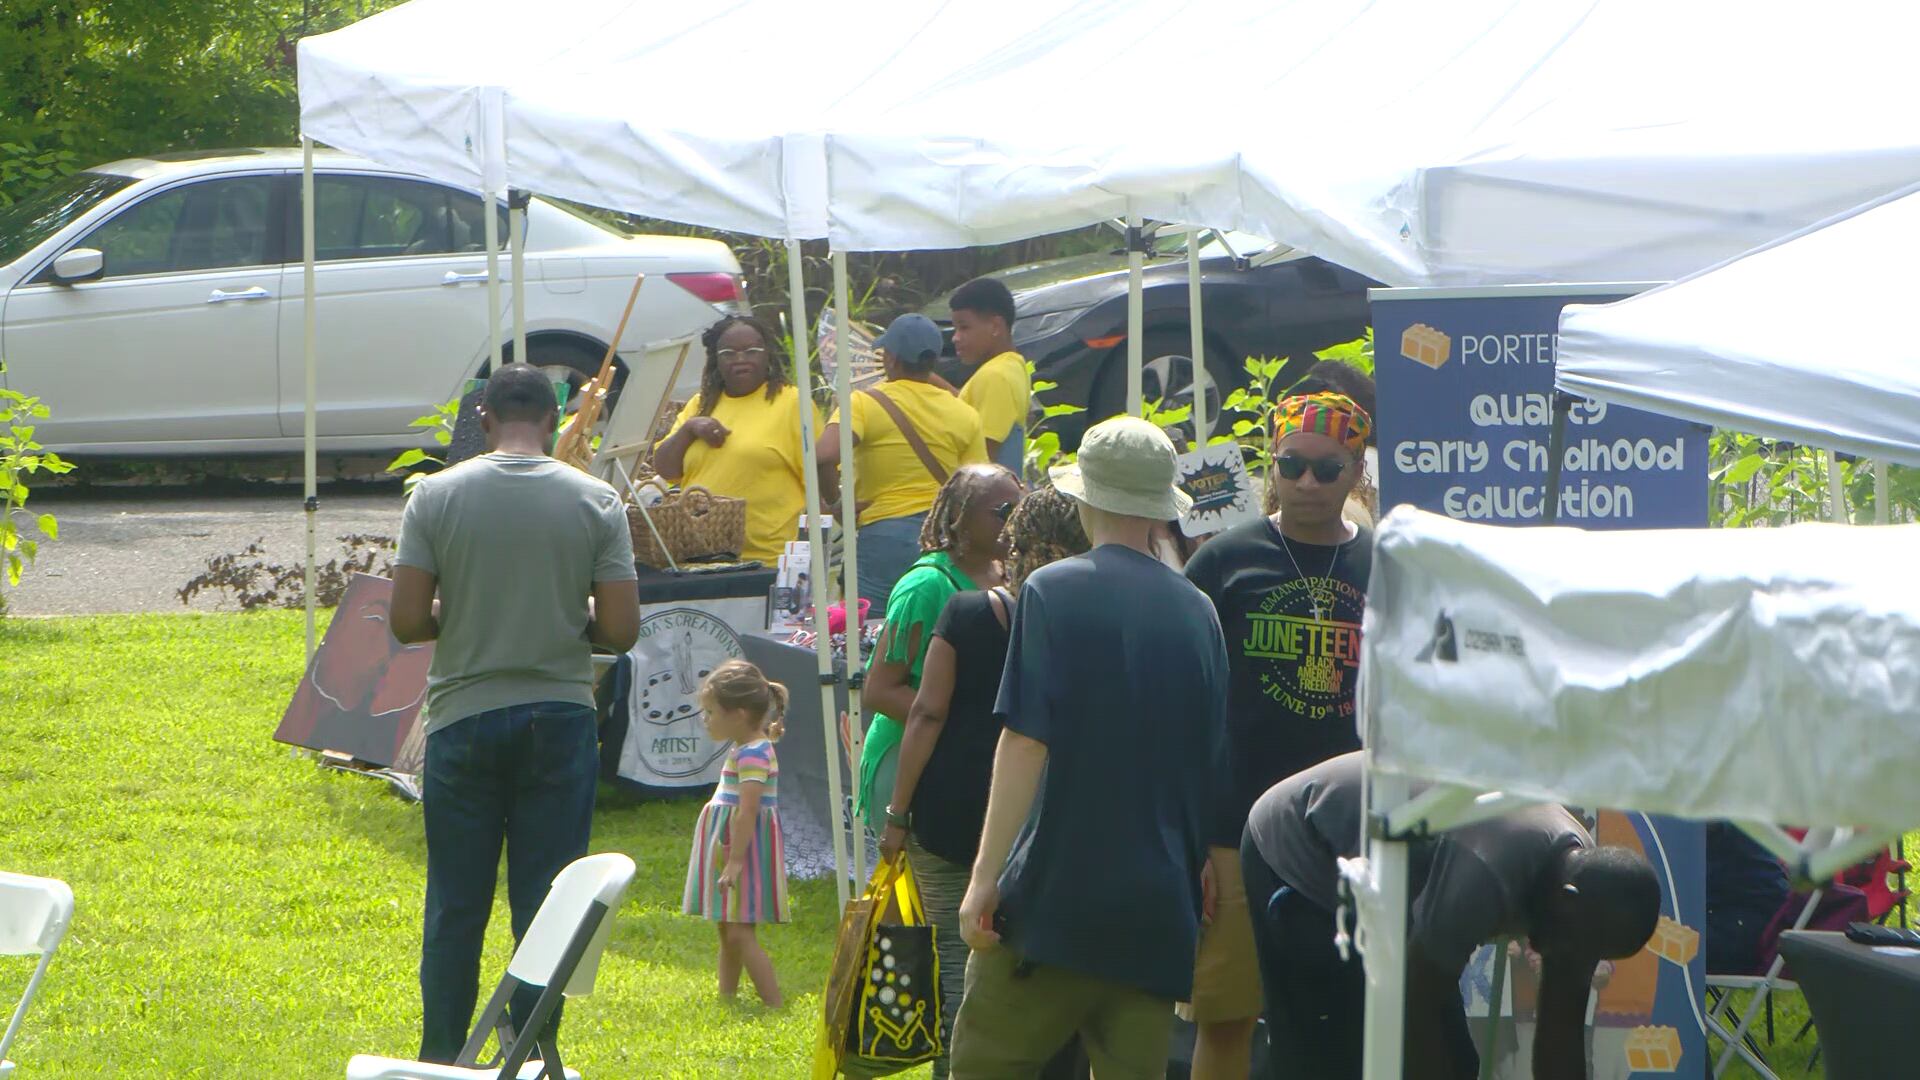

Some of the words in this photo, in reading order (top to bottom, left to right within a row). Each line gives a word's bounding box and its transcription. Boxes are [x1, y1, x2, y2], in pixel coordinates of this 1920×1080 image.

[1470, 393, 1607, 426] Qualty
[1394, 439, 1489, 473] Early
[1503, 434, 1684, 472] Chdhood
[1260, 576, 1361, 613] EMANCIPATION
[675, 614, 741, 658] CREATIONS
[1297, 666, 1343, 682] AMERICAN
[1305, 655, 1335, 668] BLACK
[1263, 683, 1306, 715] JUNE
[1300, 678, 1341, 693] FREEDOM
[651, 737, 701, 753] ARTIST
